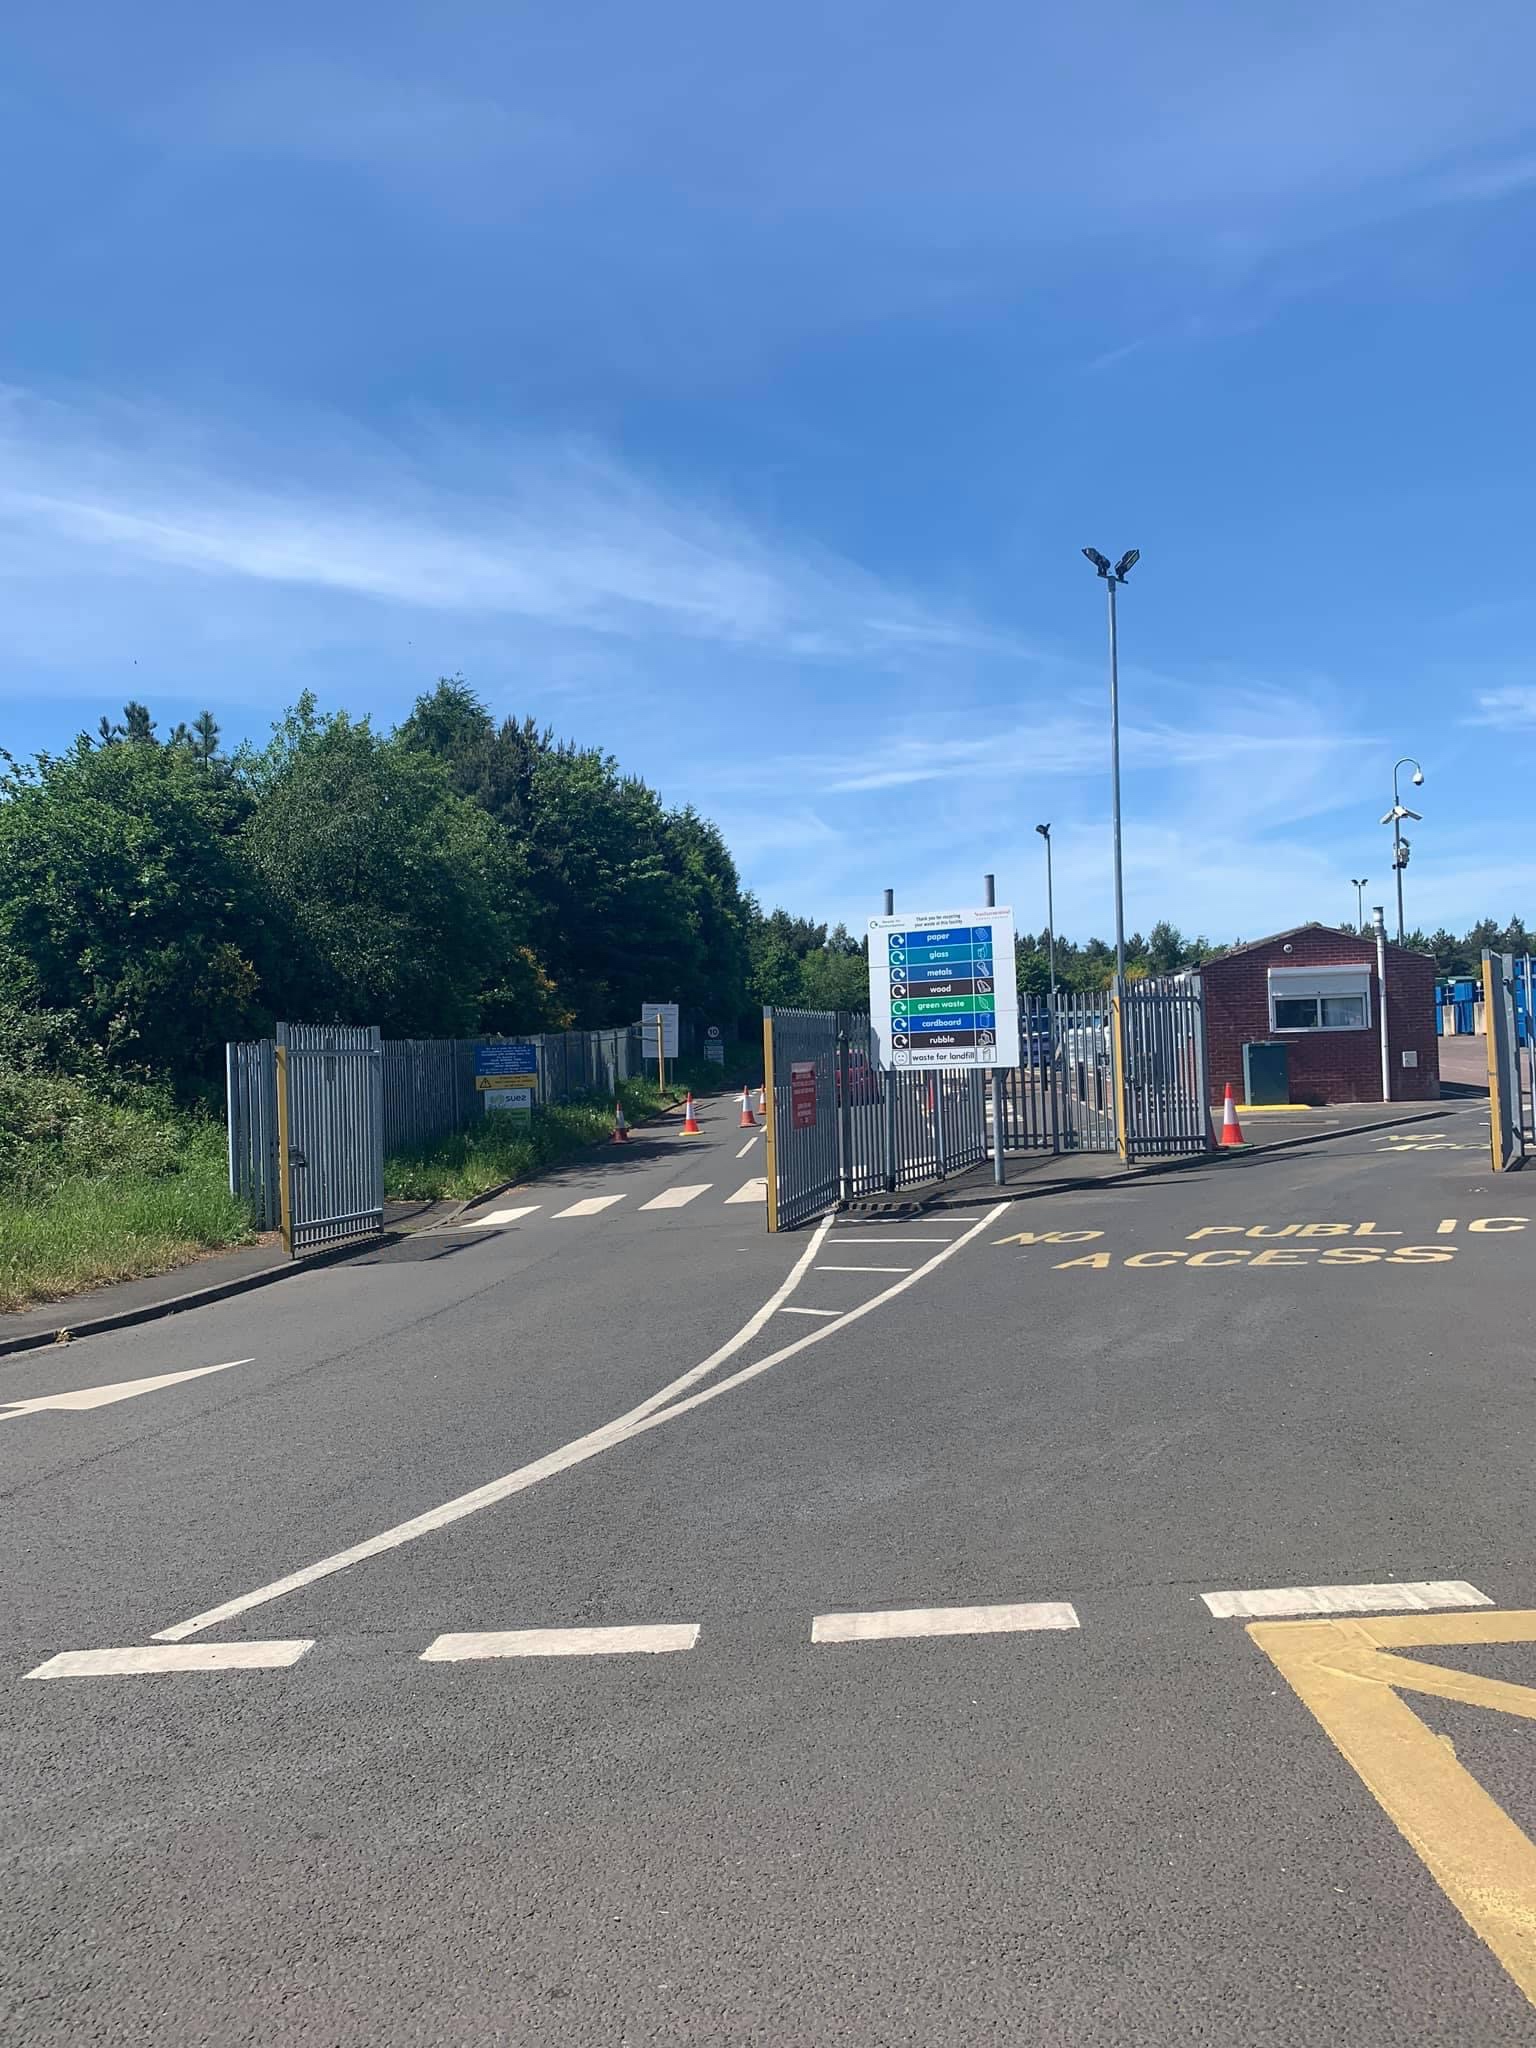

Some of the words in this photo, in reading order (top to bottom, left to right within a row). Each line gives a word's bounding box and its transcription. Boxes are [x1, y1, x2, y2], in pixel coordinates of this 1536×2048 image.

[927, 933, 950, 942] paper
[929, 950, 949, 960] glass
[927, 968, 953, 977] metals
[930, 984, 952, 993] wood
[917, 1002, 940, 1010] green
[941, 1000, 965, 1008] waste
[922, 1018, 962, 1028] cardboard
[929, 1035, 955, 1044] rubble
[912, 1054, 935, 1062] waste
[936, 1053, 948, 1061] for
[949, 1051, 975, 1060] landfill
[989, 1230, 1105, 1246] NO
[1050, 1245, 1459, 1270] ACCESS
